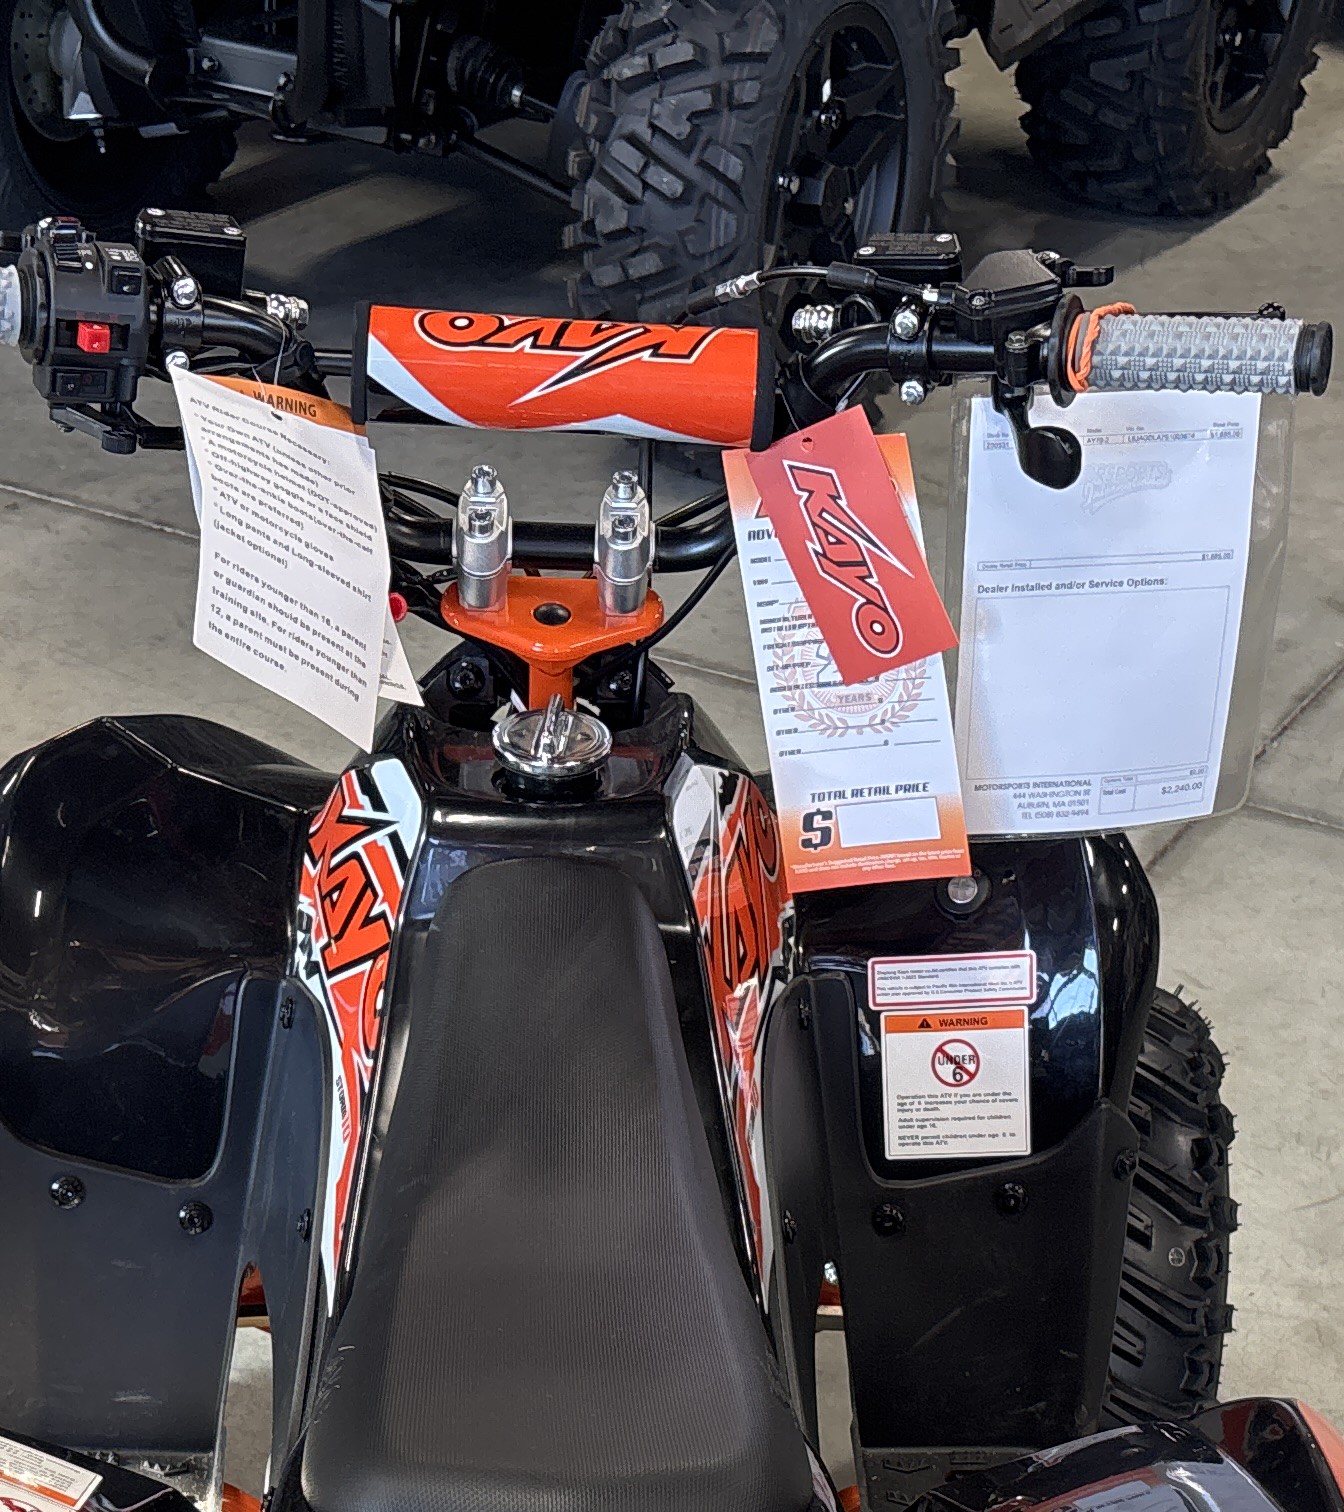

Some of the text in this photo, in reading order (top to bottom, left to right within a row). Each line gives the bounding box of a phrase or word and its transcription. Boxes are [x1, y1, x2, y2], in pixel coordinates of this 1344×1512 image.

[190, 397, 209, 413] ATV
[242, 417, 278, 436] Course
[253, 390, 317, 417] WARNING
[201, 415, 224, 429] Your
[227, 425, 250, 439] Own
[252, 436, 271, 449] ATV
[334, 480, 355, 495] prior
[218, 443, 272, 473] motorcycle
[242, 489, 257, 501] are
[219, 491, 335, 562] ATV or motorcycle gloves
[345, 522, 373, 542] shield
[213, 518, 288, 569] (jacket optional)
[219, 505, 372, 602] Long pants and Long-sleeved shirt
[782, 459, 915, 661] KAYO
[977, 577, 1168, 595] Dealer Installed and/or Service Options:
[214, 551, 230, 566] For
[232, 563, 260, 583] riders
[261, 579, 299, 607] younger
[299, 600, 319, 619] than
[341, 630, 367, 652] parent
[213, 570, 224, 580] or
[225, 577, 266, 605] guardian
[267, 602, 299, 624] should
[299, 620, 311, 632] be
[312, 628, 345, 655] present
[345, 648, 354, 660] at
[354, 654, 367, 669] the
[208, 620, 223, 636] the
[224, 631, 251, 652] entire
[211, 586, 249, 614] training
[271, 620, 287, 635] For
[288, 631, 314, 652] riders
[315, 648, 350, 675] younger
[350, 669, 367, 688] than
[210, 603, 224, 619] 12,
[232, 618, 263, 641] parent
[264, 635, 287, 655] must
[288, 648, 300, 662] be
[301, 657, 334, 683] present
[335, 678, 360, 703] during
[838, 692, 873, 704] YEARS
[810, 782, 930, 803] TOTAL RETAIL PRICE
[974, 782, 1031, 792] MOTORSPORTS
[1032, 779, 1092, 790] INTERNATIONAL
[1028, 790, 1082, 799] WASHINGTON
[1161, 782, 1203, 796] $2,240.00
[801, 808, 833, 851] $
[938, 1017, 988, 1027] WARNING
[938, 1054, 976, 1065] UNDER
[952, 1066, 963, 1083] 6
